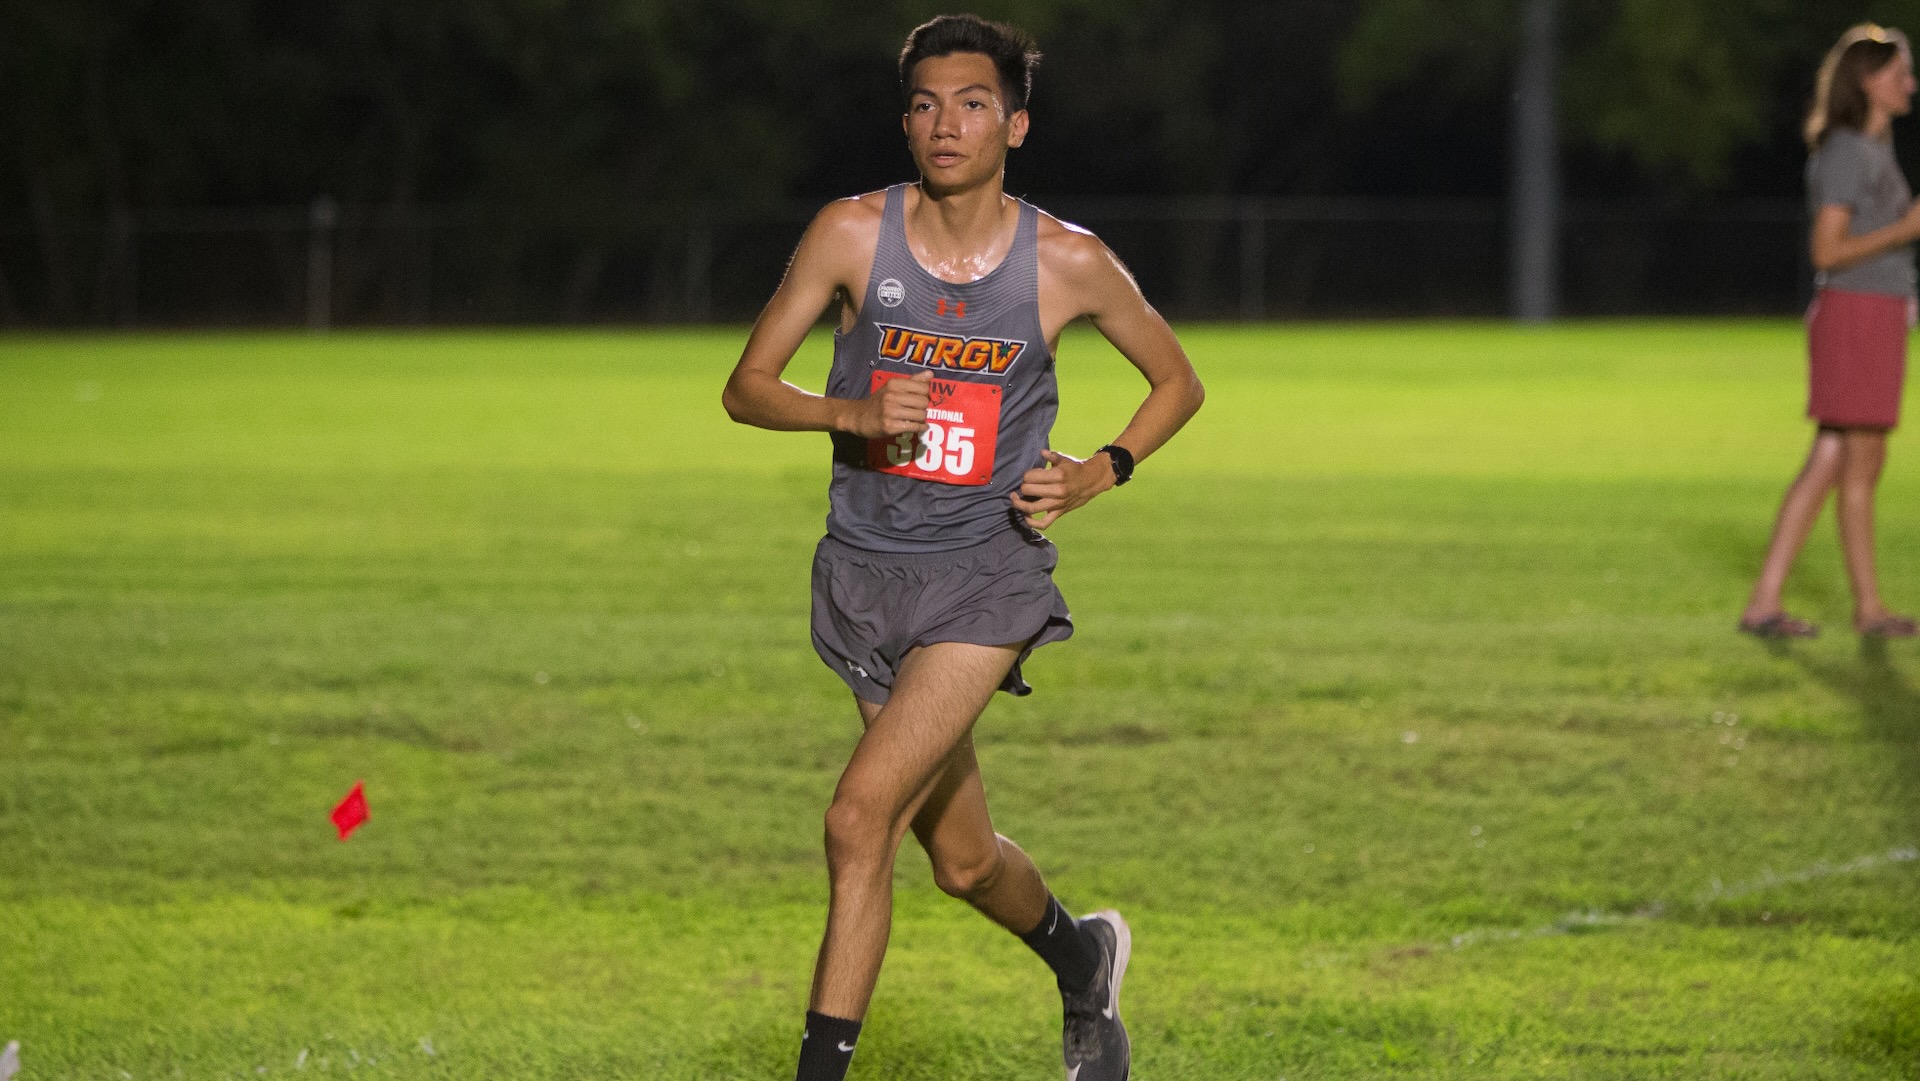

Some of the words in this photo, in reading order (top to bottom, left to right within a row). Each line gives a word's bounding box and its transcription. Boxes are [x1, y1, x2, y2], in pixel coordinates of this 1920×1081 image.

[879, 326, 1023, 373] UTRGV
[929, 382, 956, 396] IW
[886, 423, 975, 476] 385
